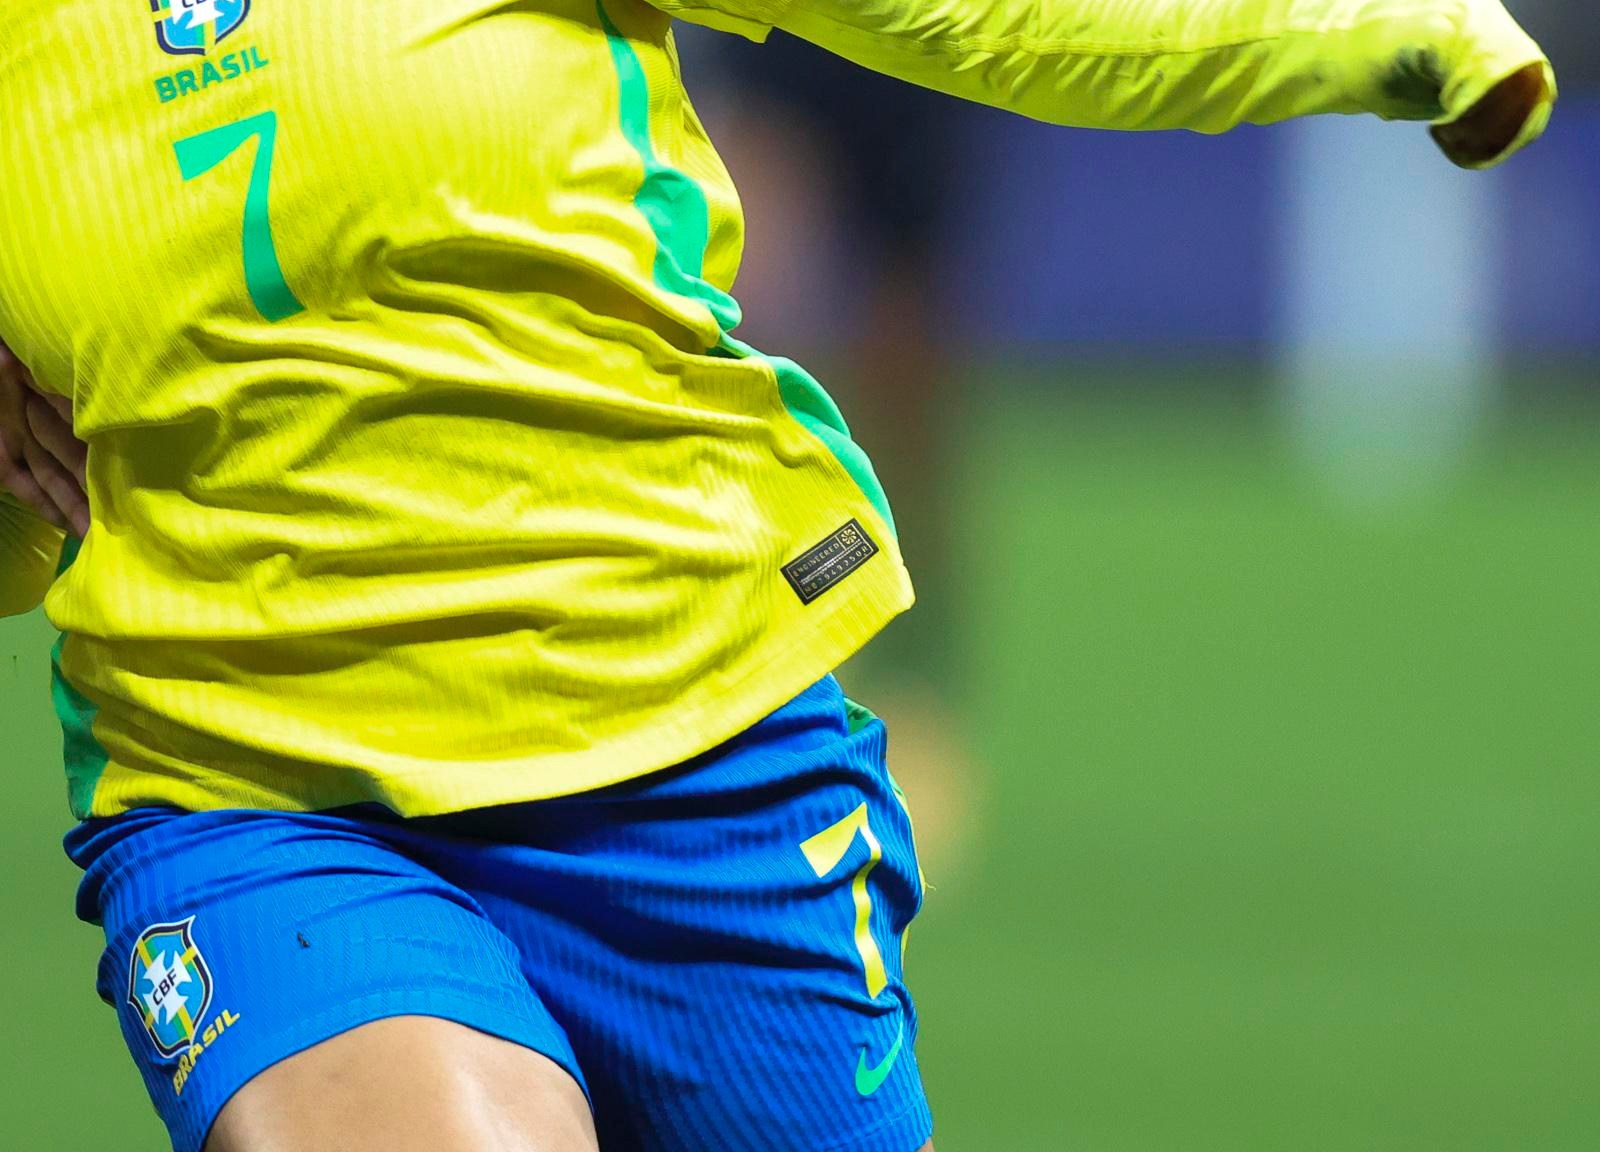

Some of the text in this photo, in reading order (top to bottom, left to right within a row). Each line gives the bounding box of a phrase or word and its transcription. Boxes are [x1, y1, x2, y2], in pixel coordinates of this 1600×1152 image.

[154, 46, 269, 104] BRASIL
[173, 110, 308, 323] 7
[799, 801, 888, 1000] 7
[152, 968, 179, 1006] CBF
[172, 1008, 241, 1097] BRASIL
